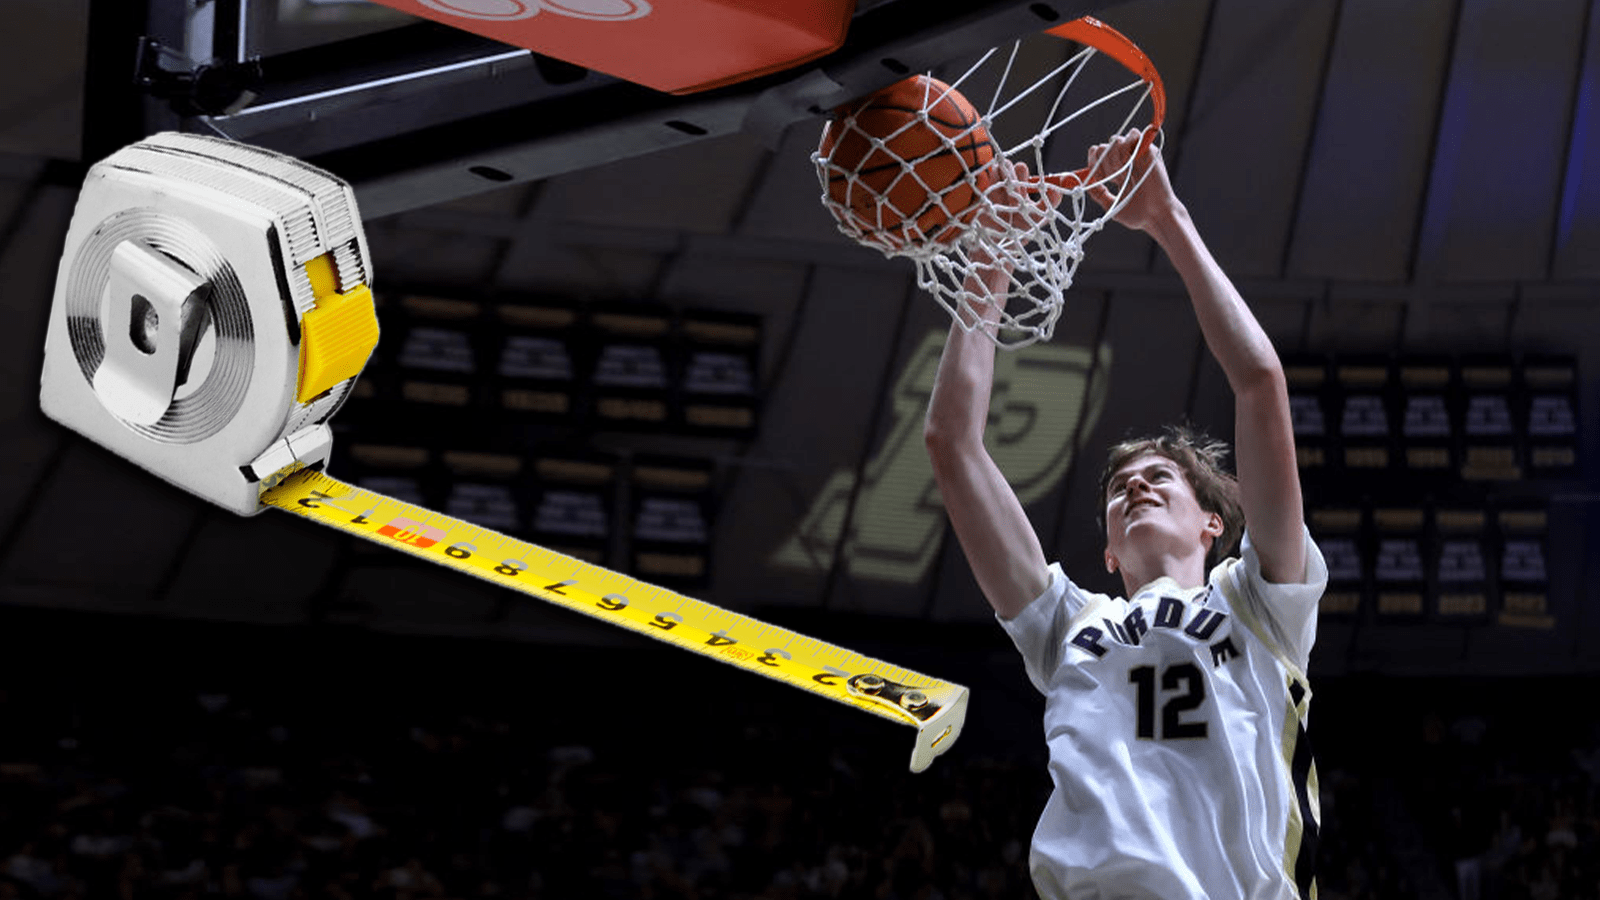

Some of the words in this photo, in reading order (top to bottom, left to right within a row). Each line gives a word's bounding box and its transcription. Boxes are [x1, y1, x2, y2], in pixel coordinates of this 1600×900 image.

[444, 541, 478, 560] 9
[493, 558, 529, 576] 8
[544, 579, 579, 596] 7
[596, 593, 630, 611] 6
[648, 611, 684, 631] 5
[705, 629, 739, 647] 4
[1070, 597, 1239, 667] PURDUE
[756, 647, 792, 667] 3
[1129, 664, 1208, 740] 12
